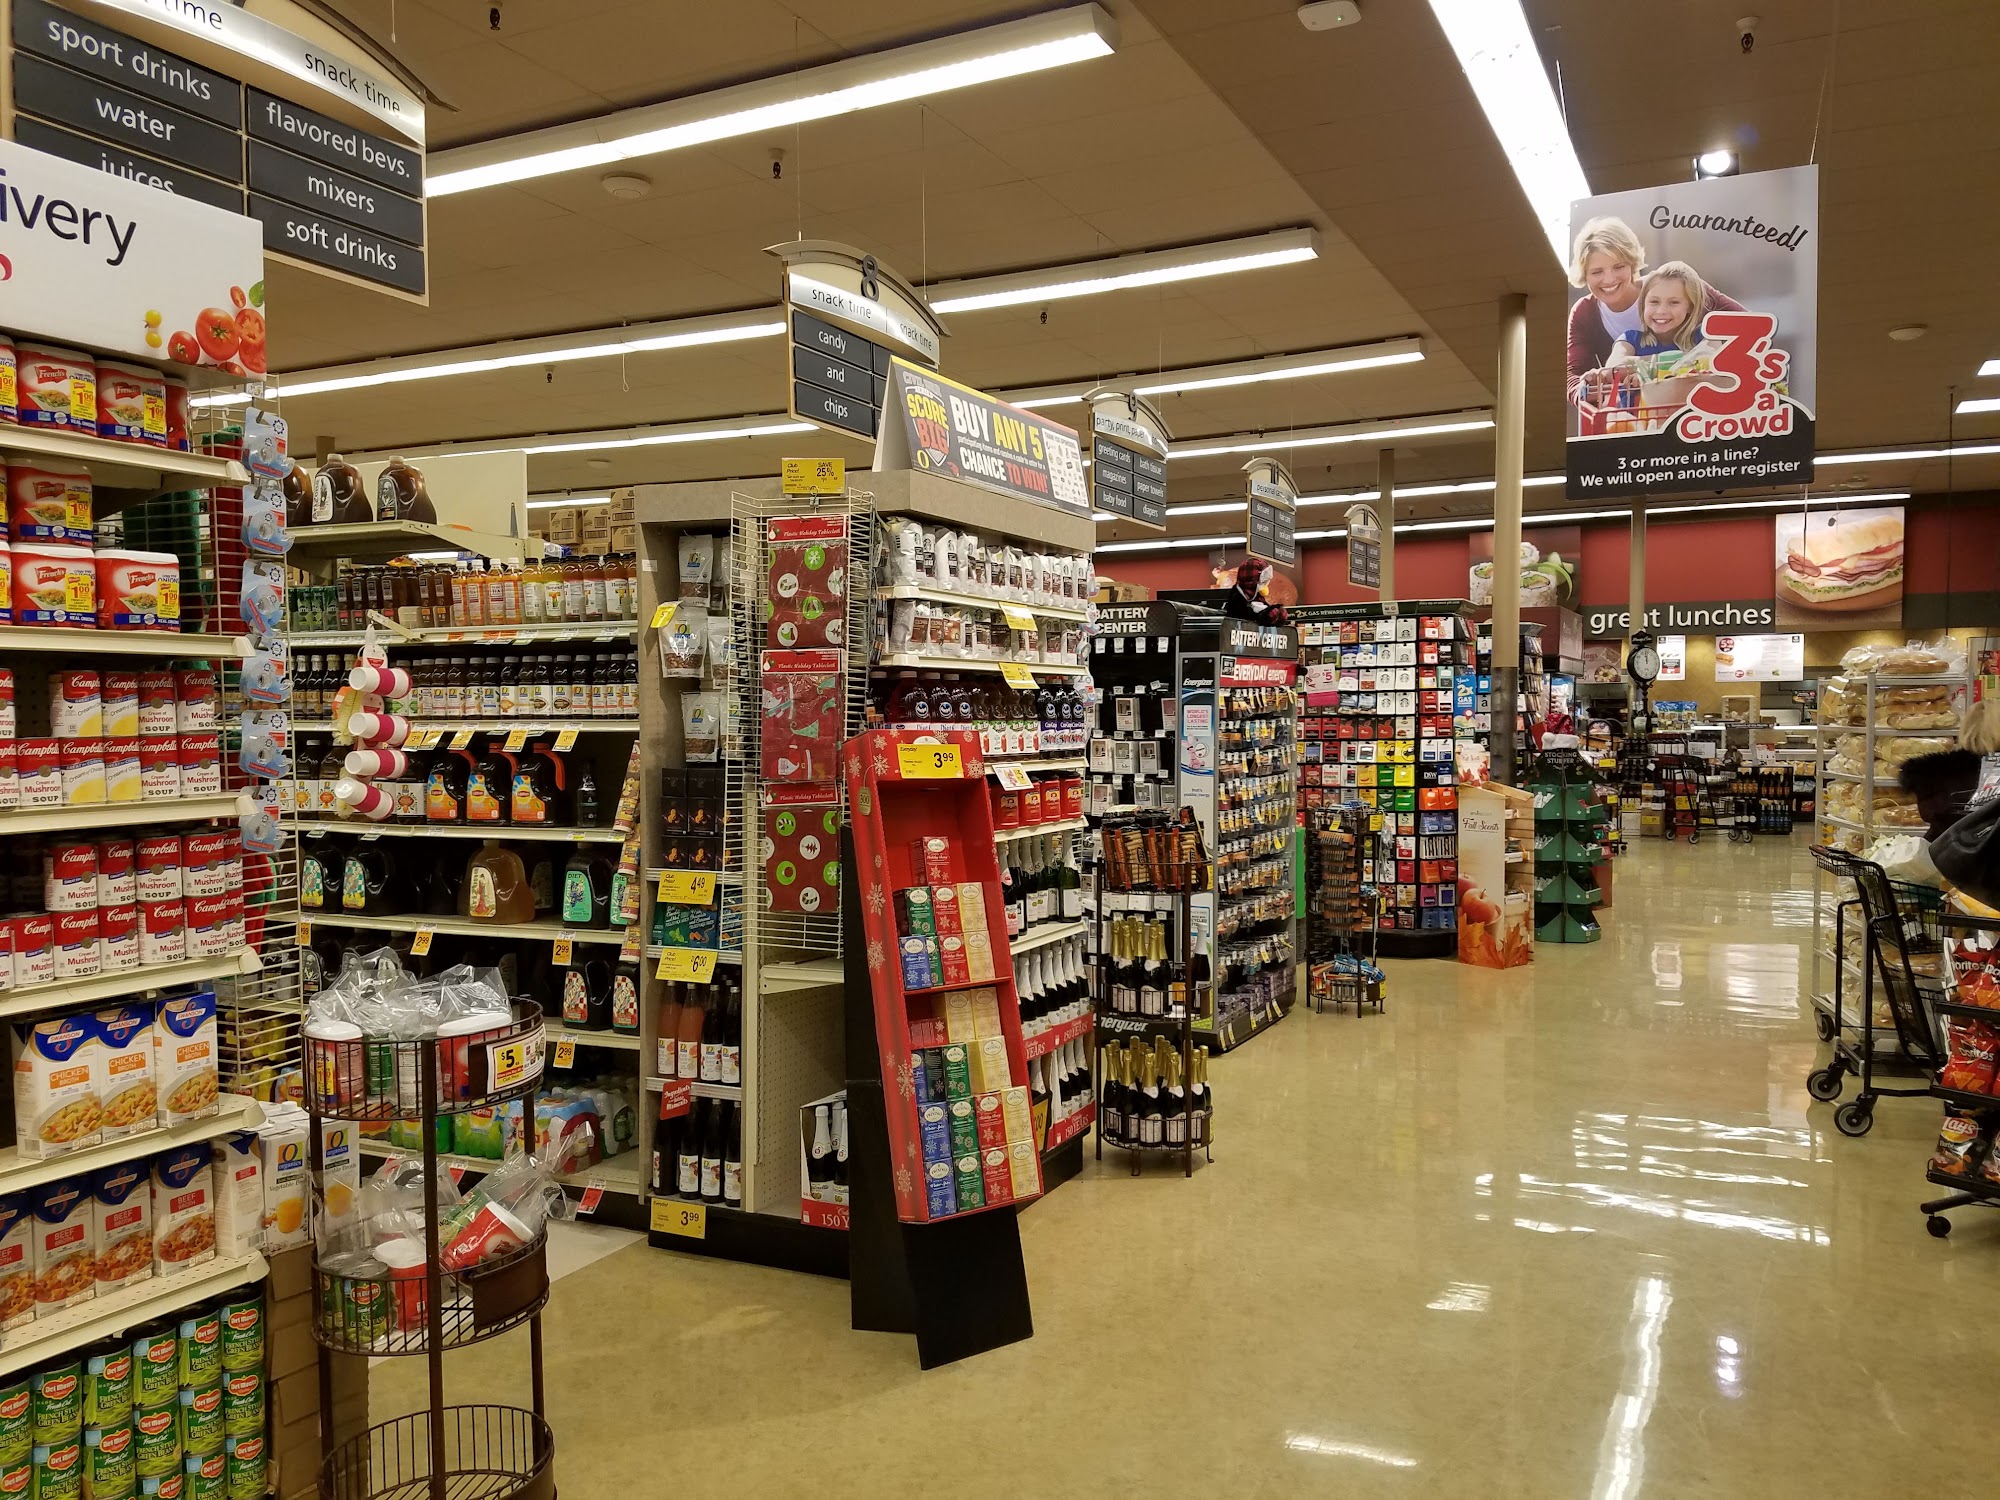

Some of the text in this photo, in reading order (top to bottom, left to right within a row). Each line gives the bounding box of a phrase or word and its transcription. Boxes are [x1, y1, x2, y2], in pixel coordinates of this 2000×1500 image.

[47, 18, 212, 101] sport drinks
[304, 49, 401, 115] snack time
[95, 98, 176, 142] water
[266, 102, 411, 178] flavored bevs.
[307, 174, 375, 214] mixers
[1649, 205, 1808, 252] Guaranteed!
[286, 219, 398, 271] soft drinks
[861, 255, 879, 302] 8
[812, 287, 871, 319] snack time
[818, 329, 847, 355] candy
[899, 322, 932, 351] snack time
[826, 365, 845, 383] and
[824, 397, 848, 419] chips
[1128, 391, 1138, 422] 9
[1757, 392, 1775, 411] a
[906, 393, 949, 430] SCORE
[949, 395, 990, 442] BUY
[992, 411, 1028, 455] ANY
[1028, 425, 1044, 460] 5
[1679, 408, 1789, 439] Crowd
[916, 418, 949, 455] BIG
[1098, 443, 1131, 463] greeting cards
[1617, 446, 1760, 470] 3 or more in a line?
[816, 467, 835, 477] 25%
[960, 446, 1007, 482] CHANCE
[1005, 461, 1022, 486] TO
[1139, 457, 1162, 475] bath tissue
[1580, 460, 1800, 487] We will open another register
[1102, 468, 1127, 485] magazines
[1136, 480, 1164, 498] paper towels
[1103, 490, 1127, 508] baby food
[1142, 503, 1159, 519] diapers
[1095, 606, 1150, 621] BATTERY
[1320, 608, 1344, 616] REWARD
[1589, 602, 1772, 635] gret lunches
[1097, 621, 1147, 634] CENTER
[1230, 629, 1288, 650] BATTERY CENTER
[1233, 664, 1268, 682] EVERYDAY
[1268, 668, 1288, 685] energy
[1458, 684, 1474, 697] 2x
[1457, 696, 1473, 704] GAS
[139, 715, 174, 723] Mushroom
[141, 779, 177, 787] Mushroom
[148, 788, 174, 796] SOUP
[1462, 817, 1500, 831] Fall Scents
[139, 881, 177, 889] Mushroom
[75, 900, 97, 908] SOUP
[145, 891, 172, 899] SOUP
[207, 946, 227, 954] SOUP
[75, 965, 98, 974] SOUP
[1950, 959, 1986, 971] oritos
[177, 1009, 204, 1019] SWANSON
[1093, 1012, 1148, 1033] nergizer
[109, 1019, 139, 1030] SWANSON
[50, 1031, 82, 1042] SWANSON
[177, 1042, 210, 1056] CHICKEN
[109, 1053, 146, 1068] CHICKEN
[50, 1067, 89, 1082] CHICKEN
[178, 1194, 196, 1204] BEEF
[113, 1210, 133, 1222] BEEF
[54, 1228, 75, 1241] BEEF
